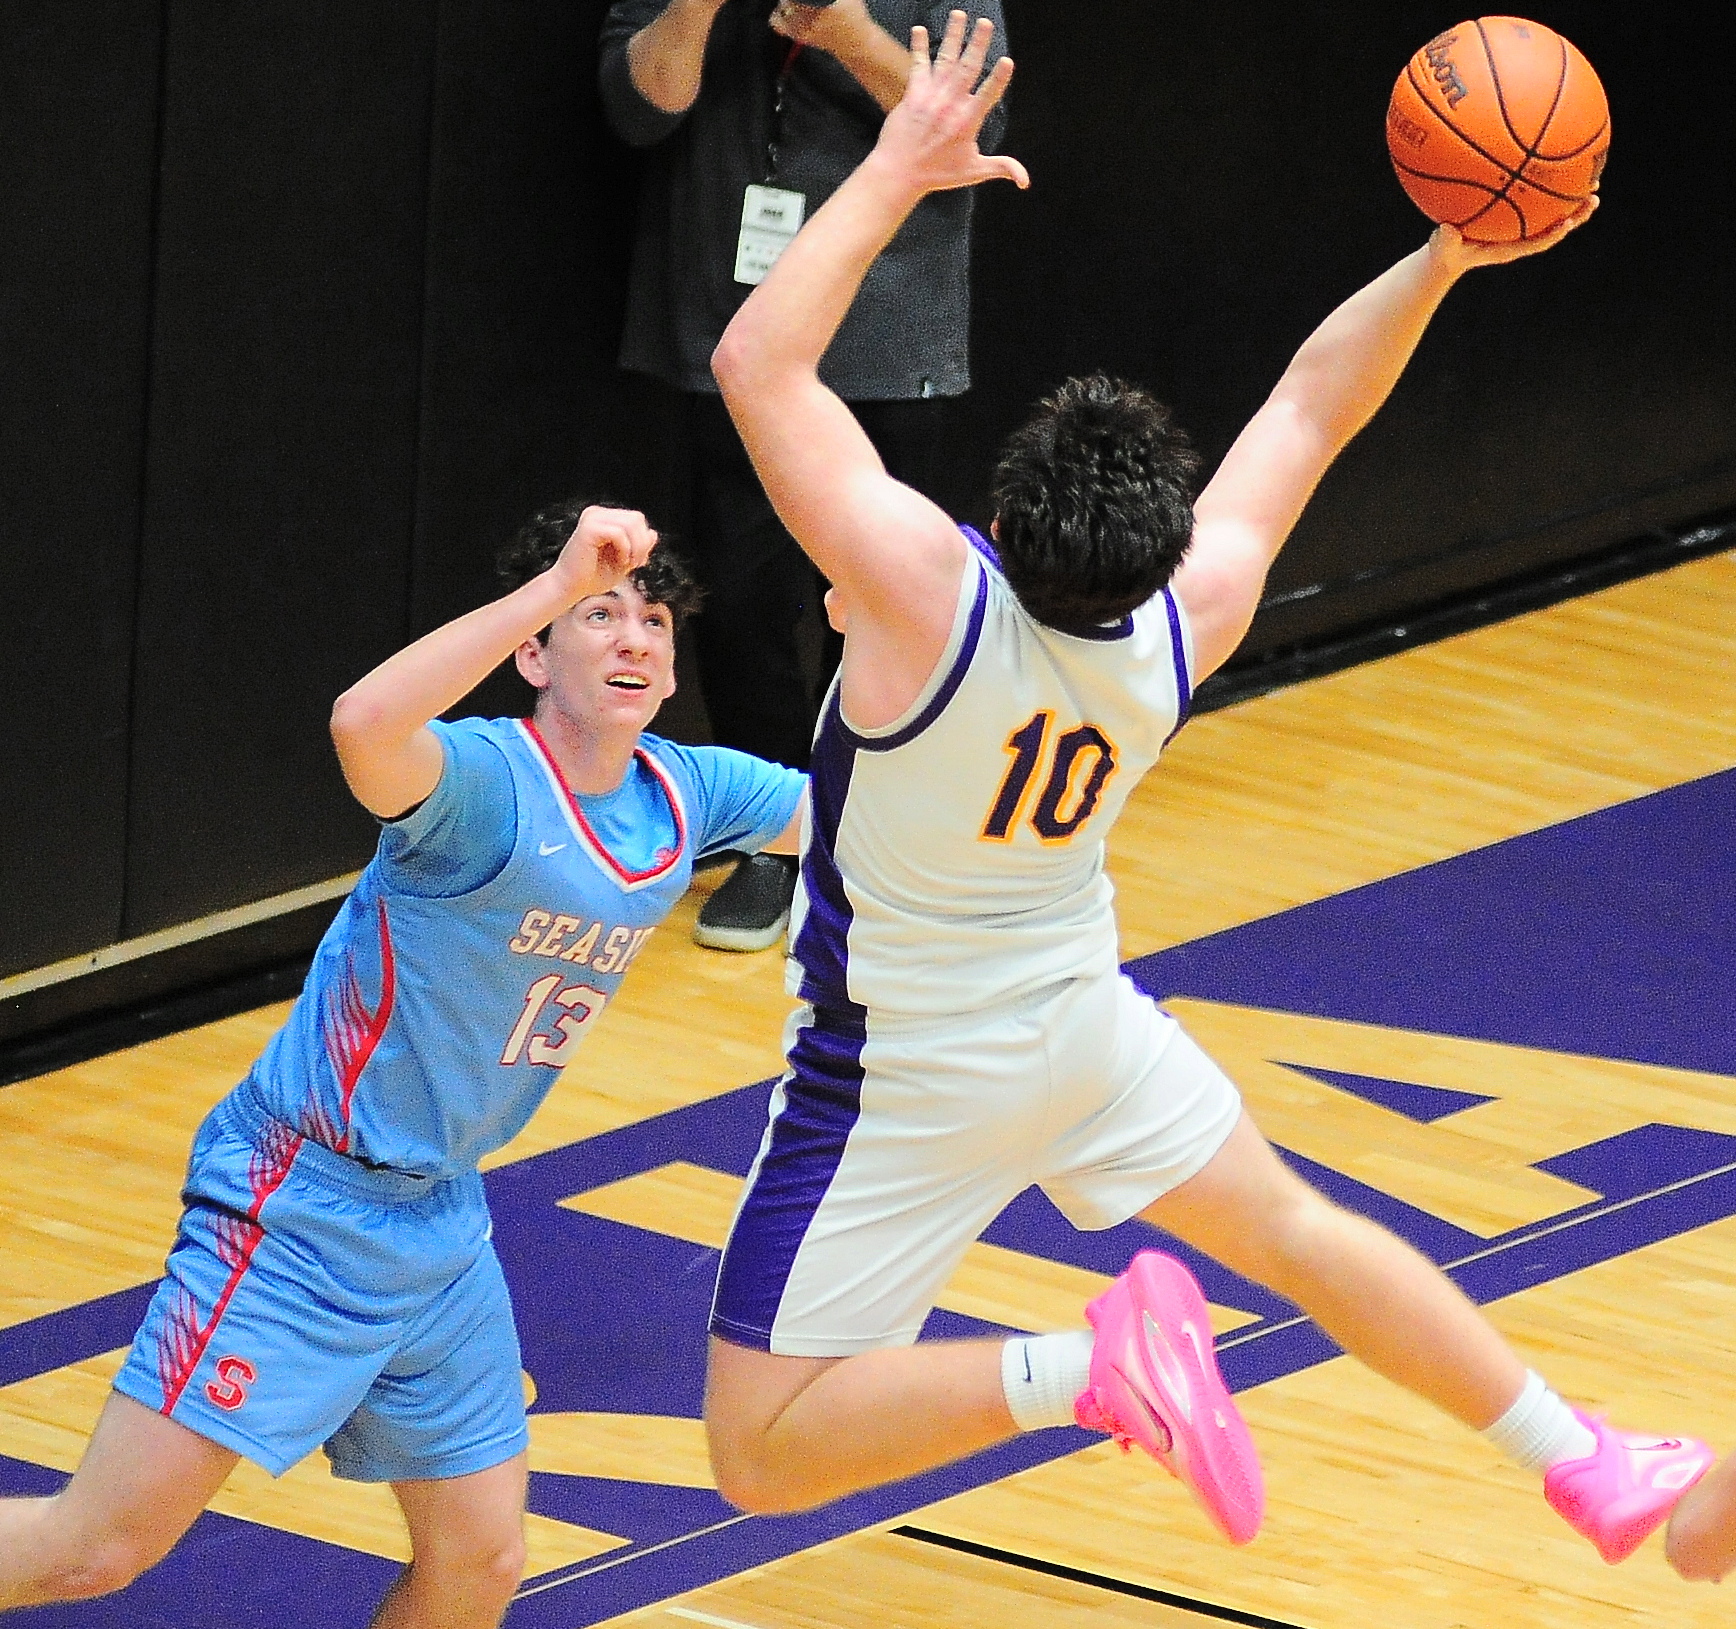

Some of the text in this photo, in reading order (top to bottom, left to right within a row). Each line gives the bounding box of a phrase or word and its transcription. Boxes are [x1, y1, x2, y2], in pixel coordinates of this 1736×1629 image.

[977, 709, 1121, 847] 10
[499, 973, 612, 1069] 13
[205, 1354, 256, 1412] S
